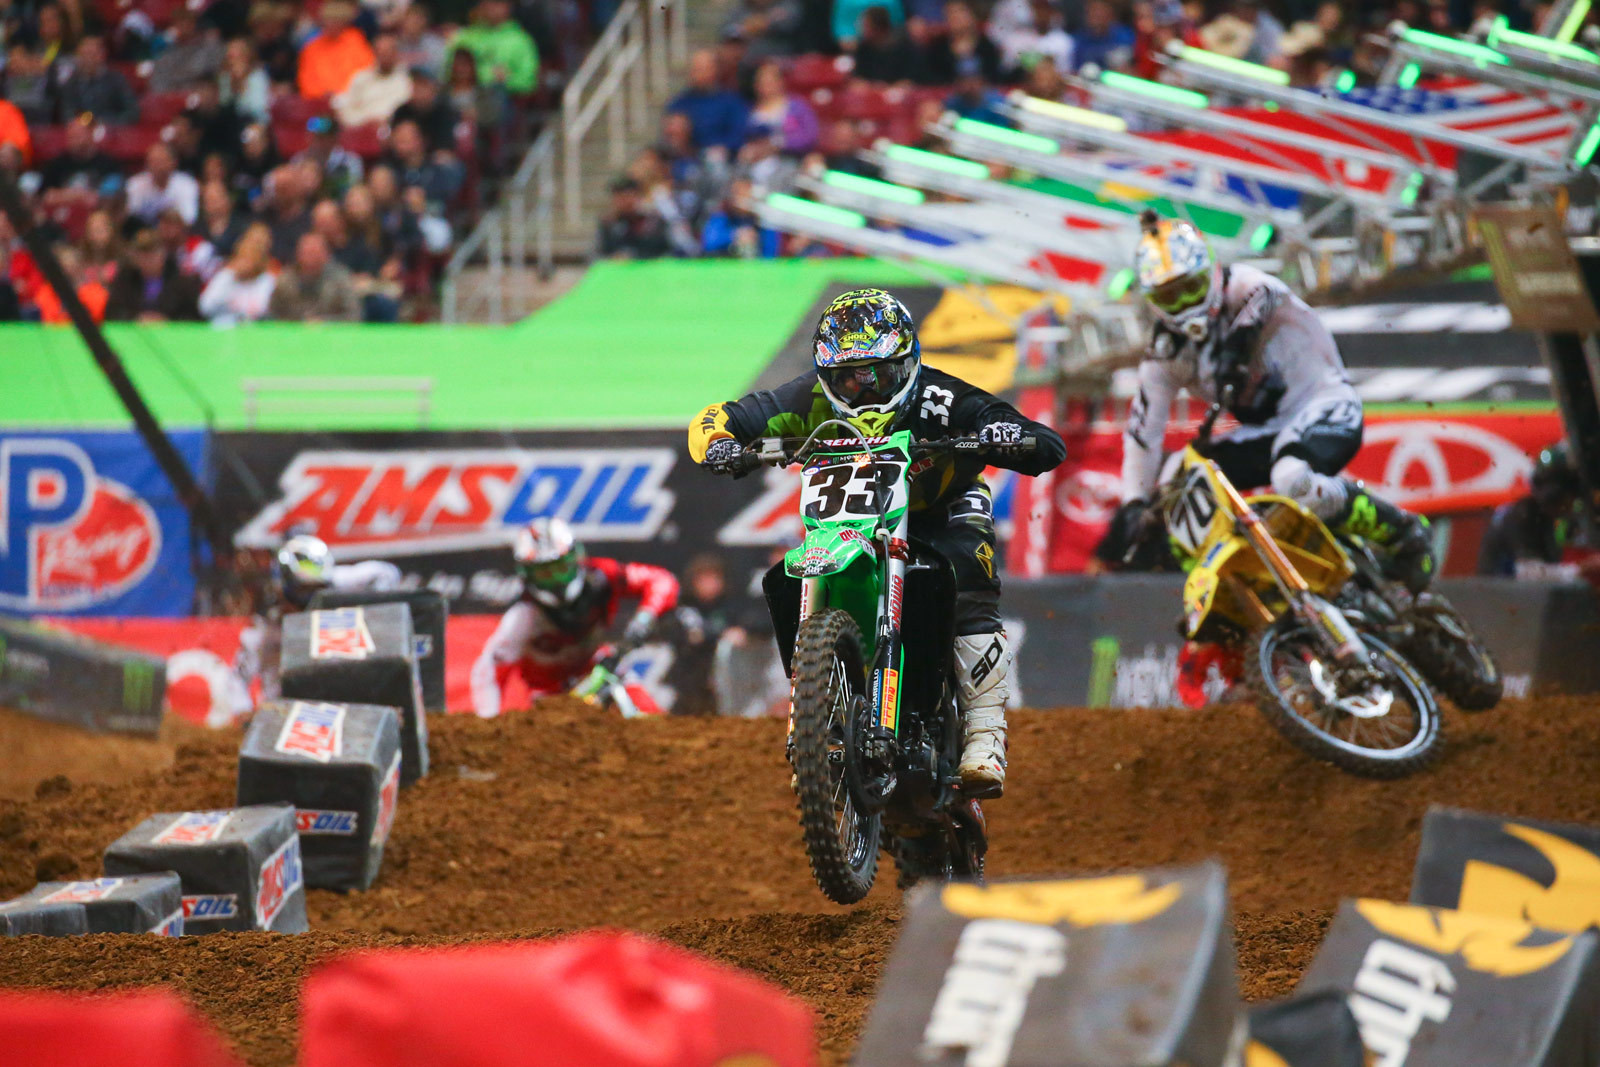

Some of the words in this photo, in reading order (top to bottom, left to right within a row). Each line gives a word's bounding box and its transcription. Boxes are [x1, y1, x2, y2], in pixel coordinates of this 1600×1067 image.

[919, 384, 955, 427] 33
[821, 437, 891, 448] RENTHA
[955, 441, 980, 449] ARC
[255, 458, 662, 549] AMSOIL
[805, 463, 902, 521] 33
[971, 635, 1004, 689] SIDI
[871, 668, 880, 708] CARRILLO
[296, 811, 354, 832] SOIL
[182, 897, 234, 917] SOIL
